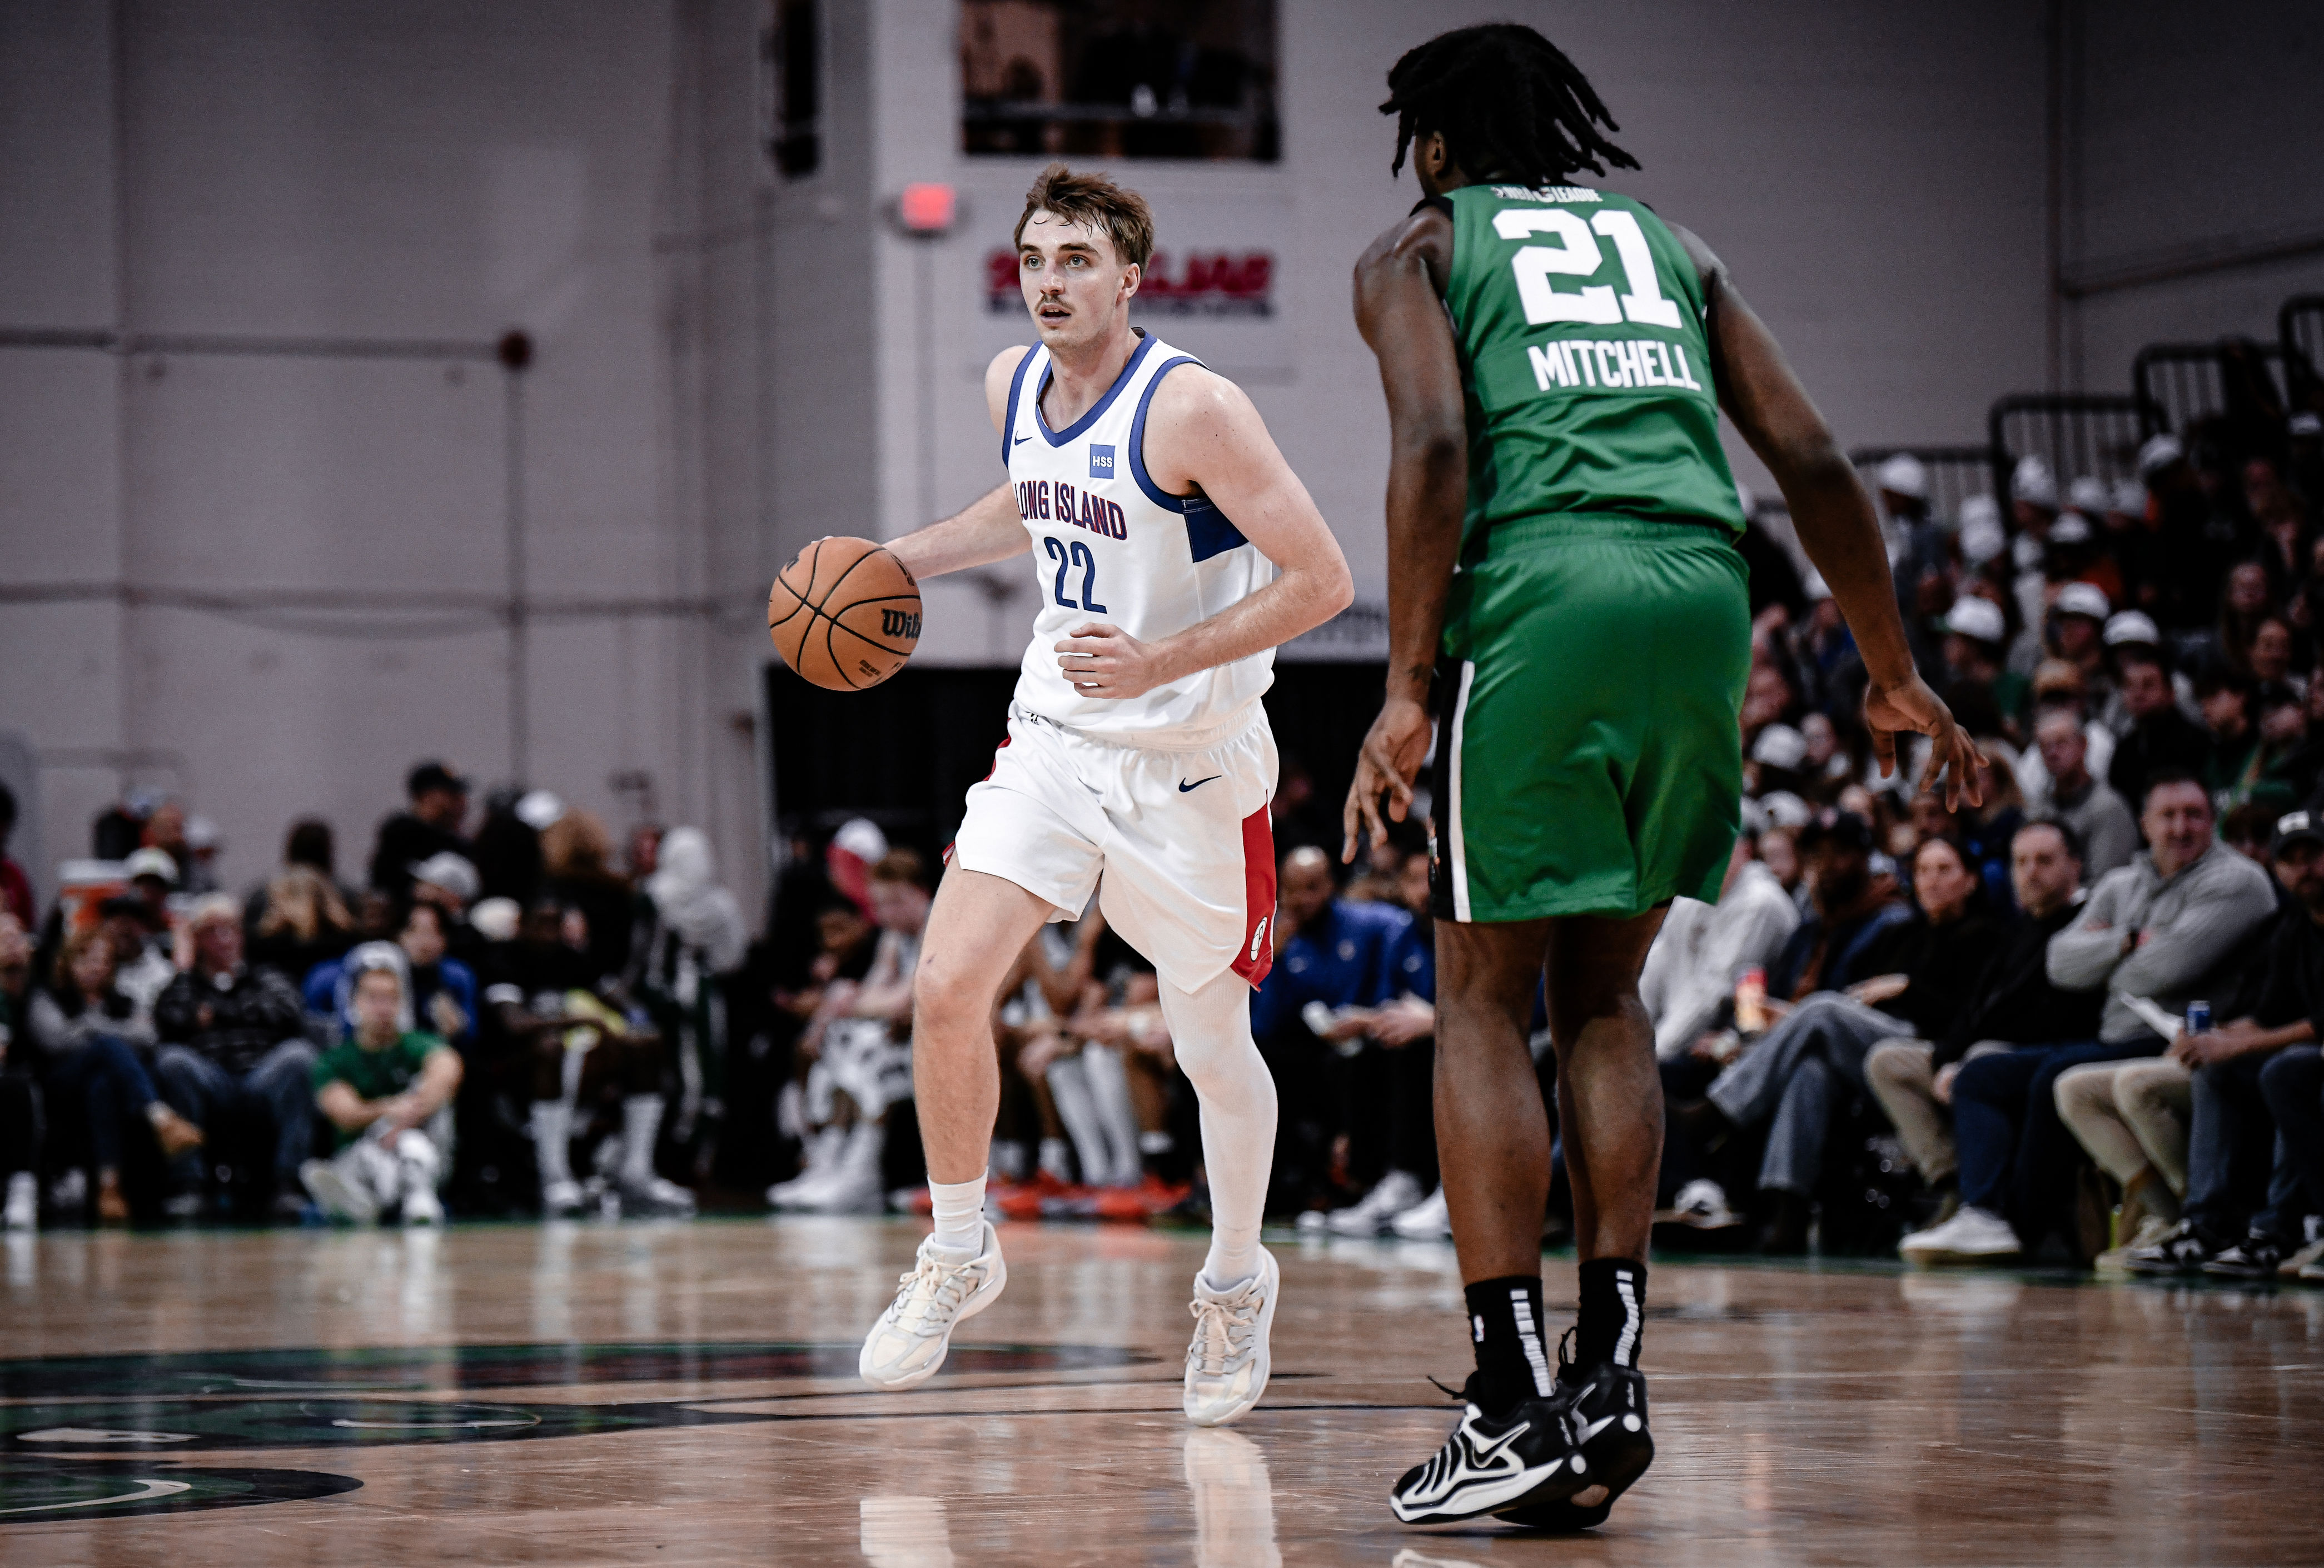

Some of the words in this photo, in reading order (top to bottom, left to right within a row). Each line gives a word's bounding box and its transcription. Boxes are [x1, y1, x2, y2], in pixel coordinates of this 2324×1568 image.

[1492, 208, 1683, 329] 21
[1527, 340, 1701, 392] MITCHELL
[1092, 455, 1113, 468] HSS
[1054, 481, 1128, 541] ISLAND
[1043, 536, 1108, 615] 22
